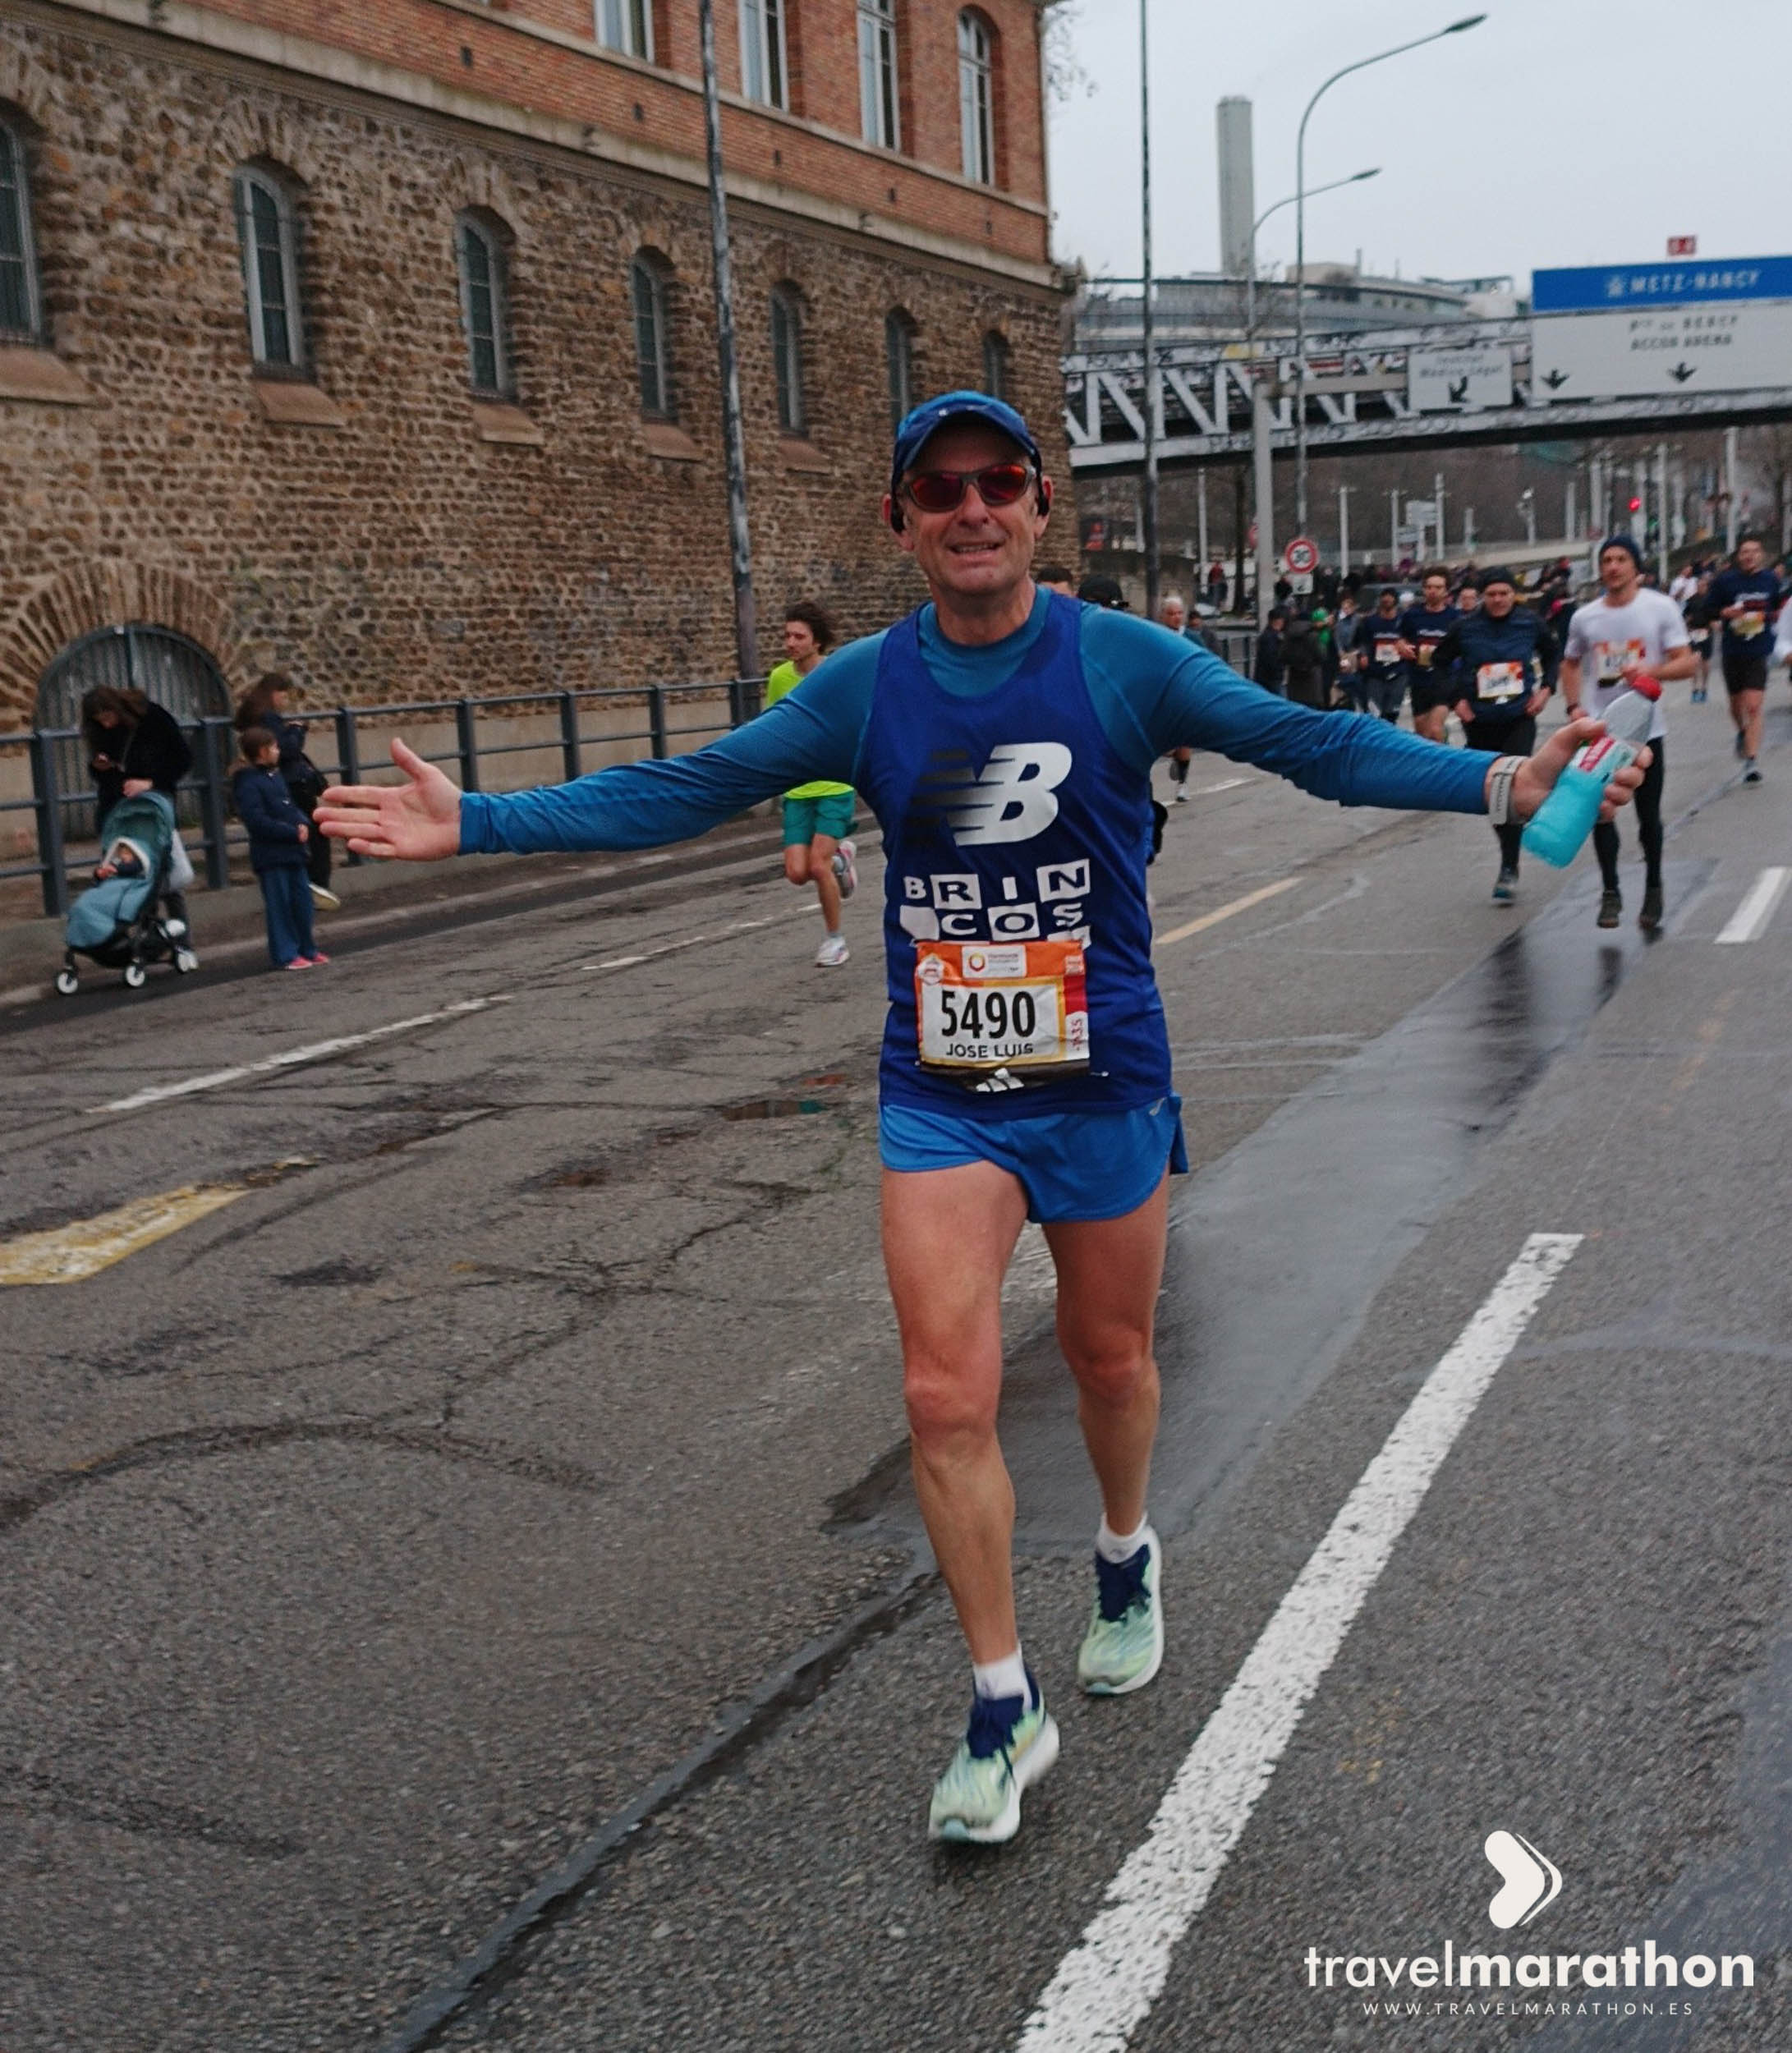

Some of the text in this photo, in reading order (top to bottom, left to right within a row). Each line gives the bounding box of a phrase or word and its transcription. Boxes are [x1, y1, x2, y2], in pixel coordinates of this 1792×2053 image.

[941, 990, 1036, 1039] 5490
[946, 1042, 1034, 1059] JOSE LUIS
